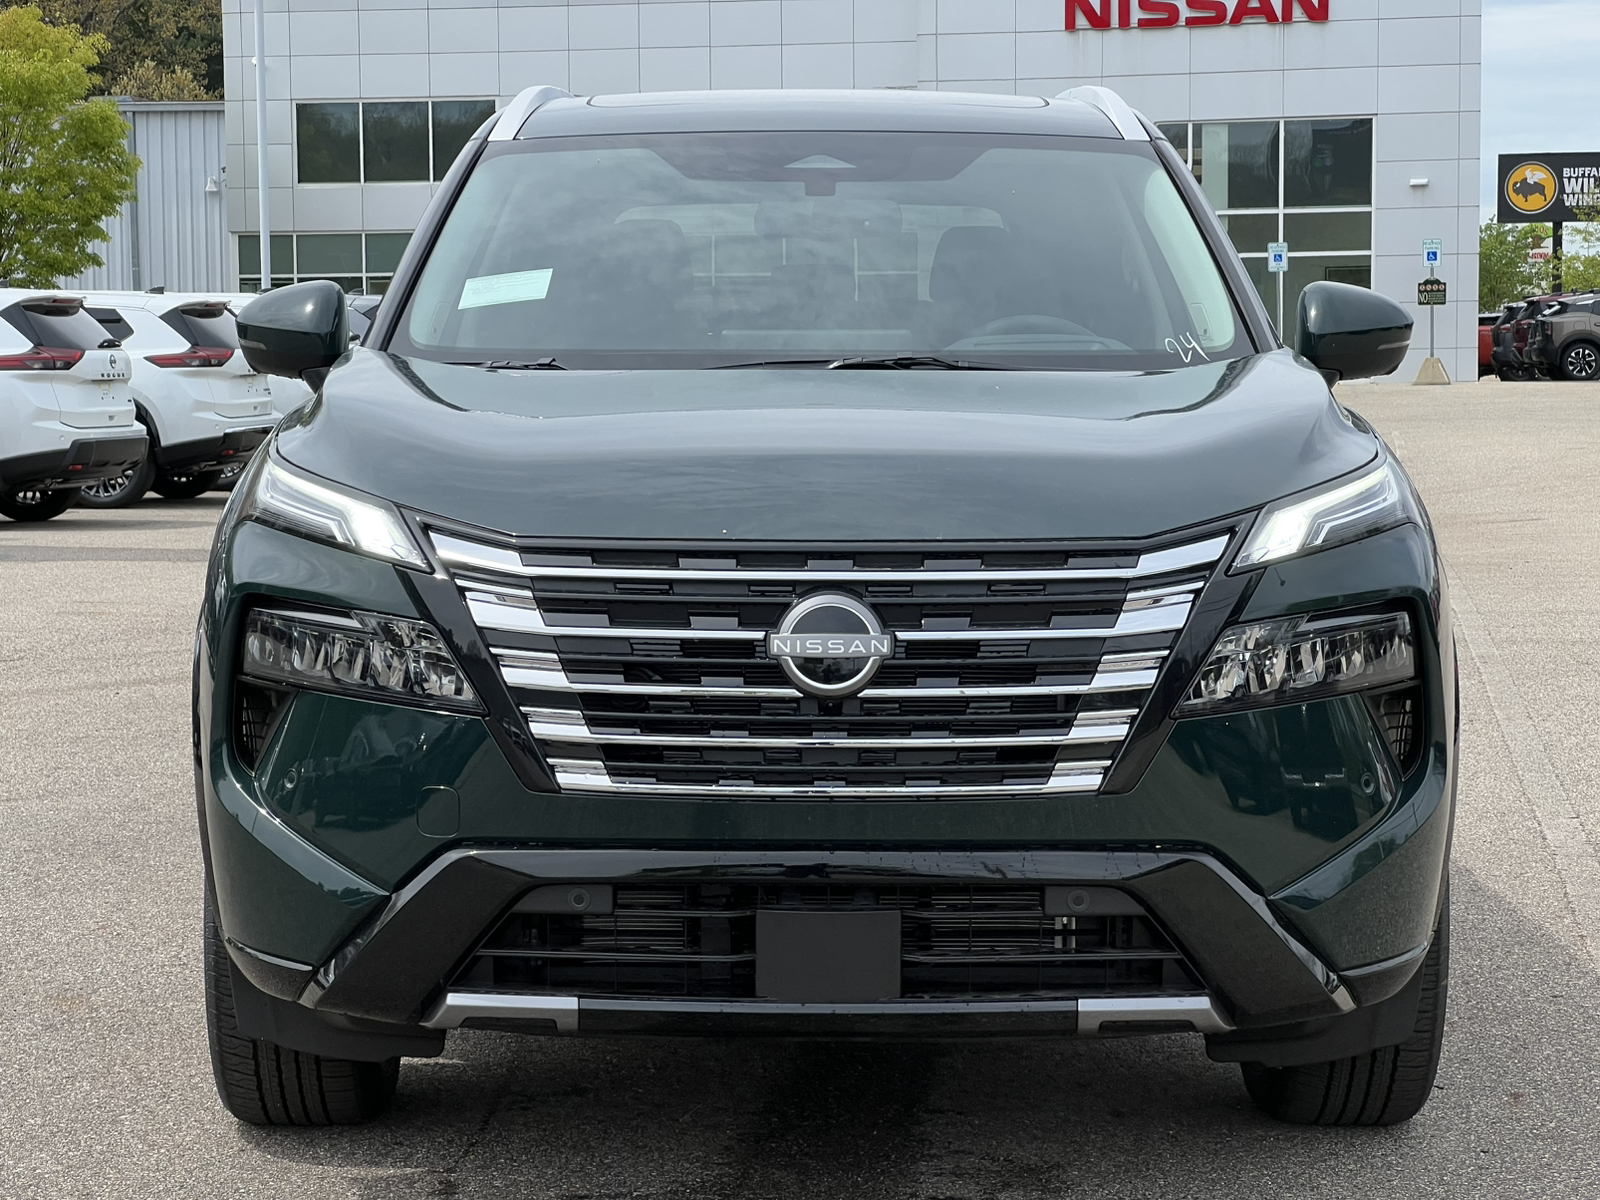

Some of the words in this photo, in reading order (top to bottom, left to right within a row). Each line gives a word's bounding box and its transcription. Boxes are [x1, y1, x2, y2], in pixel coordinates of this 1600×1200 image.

[1065, 0, 1329, 31] NISSAN
[1418, 292, 1429, 303] NO
[1164, 331, 1211, 363] 24
[773, 639, 888, 654] NISSAN
